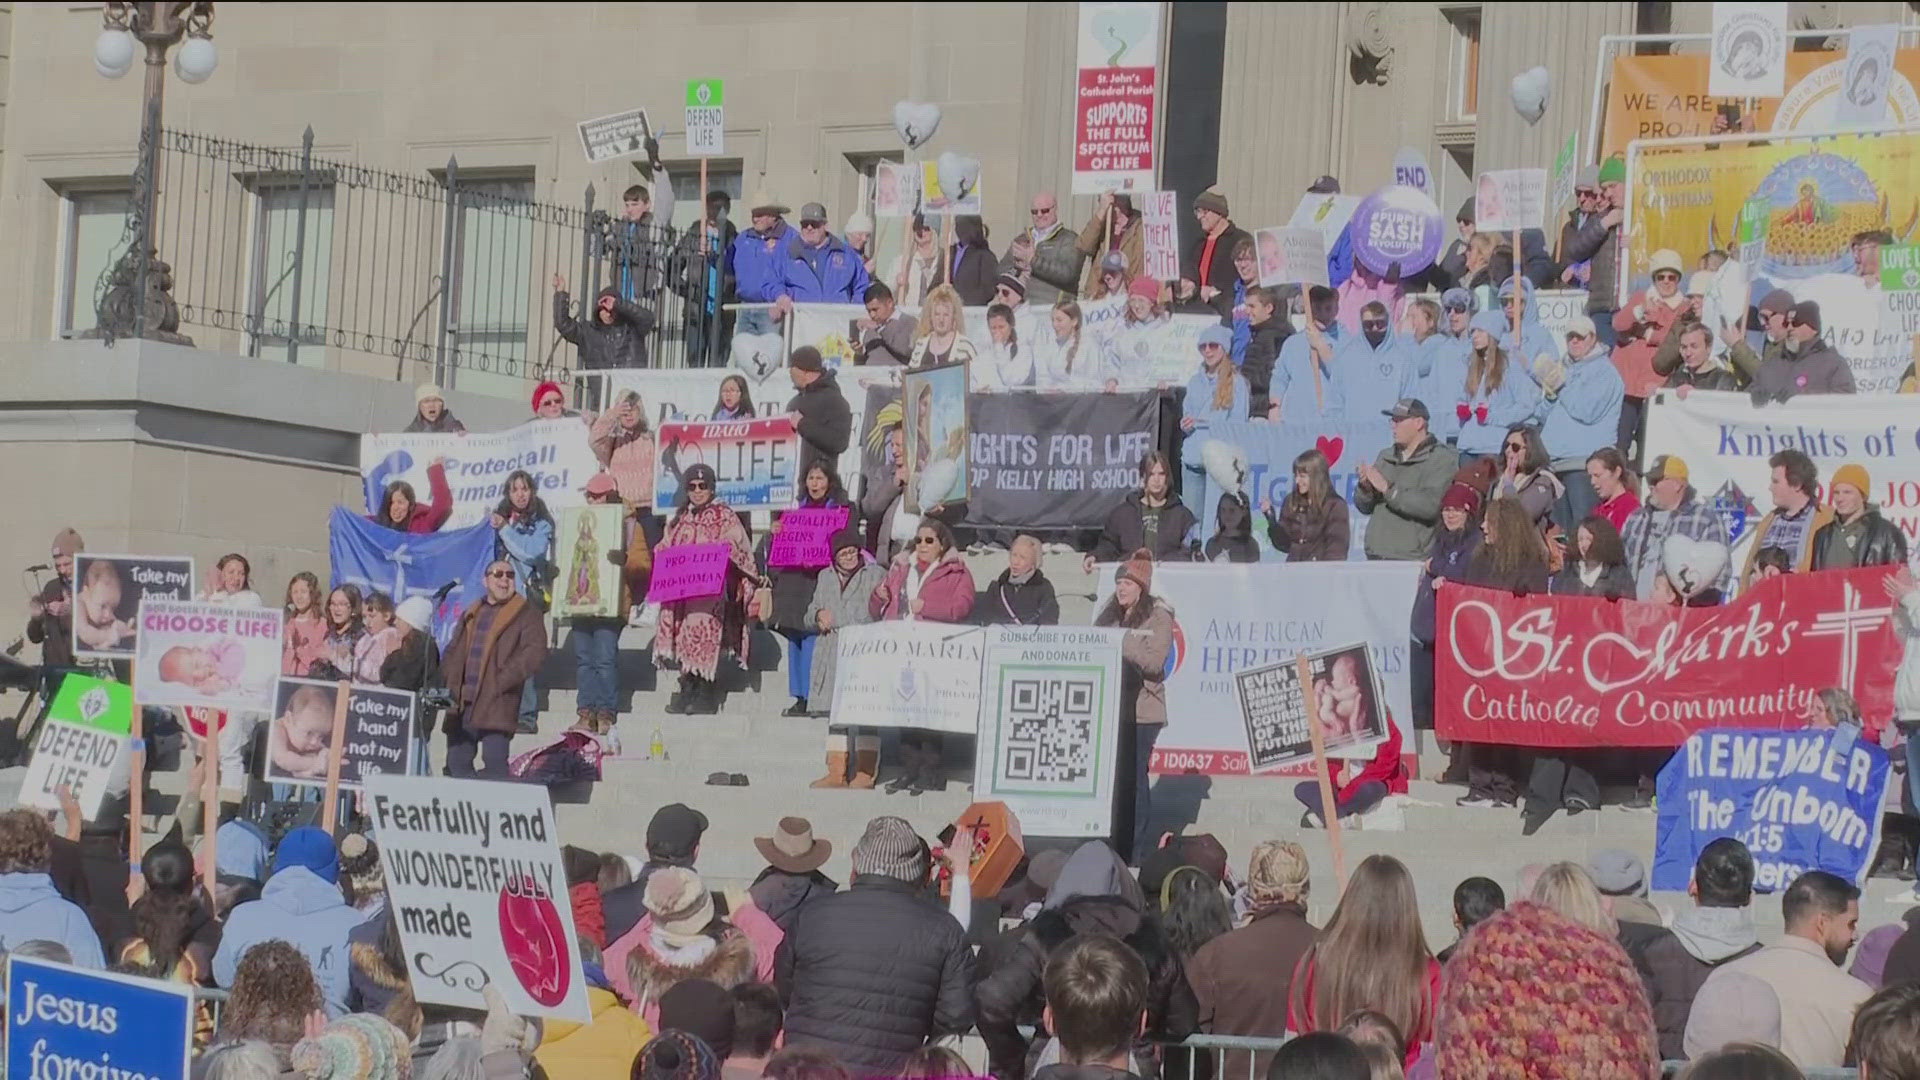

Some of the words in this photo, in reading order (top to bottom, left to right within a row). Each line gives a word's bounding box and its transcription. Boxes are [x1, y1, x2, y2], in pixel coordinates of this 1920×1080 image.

[1097, 74, 1108, 84] St.
[1109, 73, 1140, 84] John's
[1081, 86, 1125, 97] Cathedral
[1127, 85, 1154, 96] Parish
[1624, 93, 1659, 111] WE
[1666, 95, 1713, 112] ARE
[687, 109, 721, 126] DEFEND
[1086, 101, 1147, 127] SUPPORTS
[695, 129, 714, 146] LIFE
[1086, 127, 1111, 140] THE
[1114, 126, 1146, 140] FULL
[1079, 141, 1150, 156] SPECTRUM
[1091, 157, 1110, 170] OF
[1113, 156, 1140, 169] LIFE
[1396, 166, 1426, 188] END
[1144, 223, 1172, 249] THEM
[1369, 219, 1425, 241] SASH
[1882, 247, 1911, 270] LOVE
[703, 423, 750, 439] IDAHO
[1717, 424, 1848, 458] Knights
[1864, 426, 1897, 457] of
[525, 445, 556, 467] all
[1048, 433, 1093, 466] FOR
[717, 440, 786, 482] LIFE
[996, 469, 1043, 491] KELLY
[1047, 469, 1084, 490] HIGH
[1091, 468, 1144, 490] SCHOO
[774, 531, 814, 543] BEGINS
[131, 566, 164, 585] Take
[165, 570, 190, 588] my
[141, 585, 179, 600] hand
[144, 615, 229, 634] CHOOSE
[235, 619, 278, 640] LIFE!
[1000, 631, 1058, 645] SUBSCRIBE
[1061, 632, 1077, 644] TO
[1078, 633, 1110, 645] EMAIL
[1205, 618, 1327, 643] AMERICAN
[1020, 649, 1044, 662] AND
[1045, 650, 1091, 663] DONATE
[1450, 600, 1575, 681] St.
[1583, 601, 1799, 693] Mark's
[1243, 667, 1288, 689] EVEN
[1292, 659, 1325, 680] TE
[348, 696, 385, 716] Take
[386, 704, 409, 721] my
[1463, 683, 1600, 729] Catholic
[1615, 682, 1816, 728] Community
[357, 719, 398, 738] hand
[1255, 725, 1275, 741] OF
[1279, 718, 1309, 736] THE
[40, 723, 118, 768] DEFEND
[348, 740, 376, 758] not
[377, 744, 402, 762] my
[1257, 731, 1310, 752] FUTURE
[357, 760, 383, 776] life
[1164, 754, 1213, 770] ID0637
[1687, 733, 1872, 795] REMEMBER
[42, 763, 88, 800] LIFE
[374, 795, 490, 848] Fearfully
[500, 807, 547, 842] and
[1687, 790, 1735, 831] The
[1751, 784, 1867, 849] Unborn
[387, 849, 553, 899] WONDERFULLY
[401, 903, 472, 939] made
[17, 981, 117, 1034] Jesus
